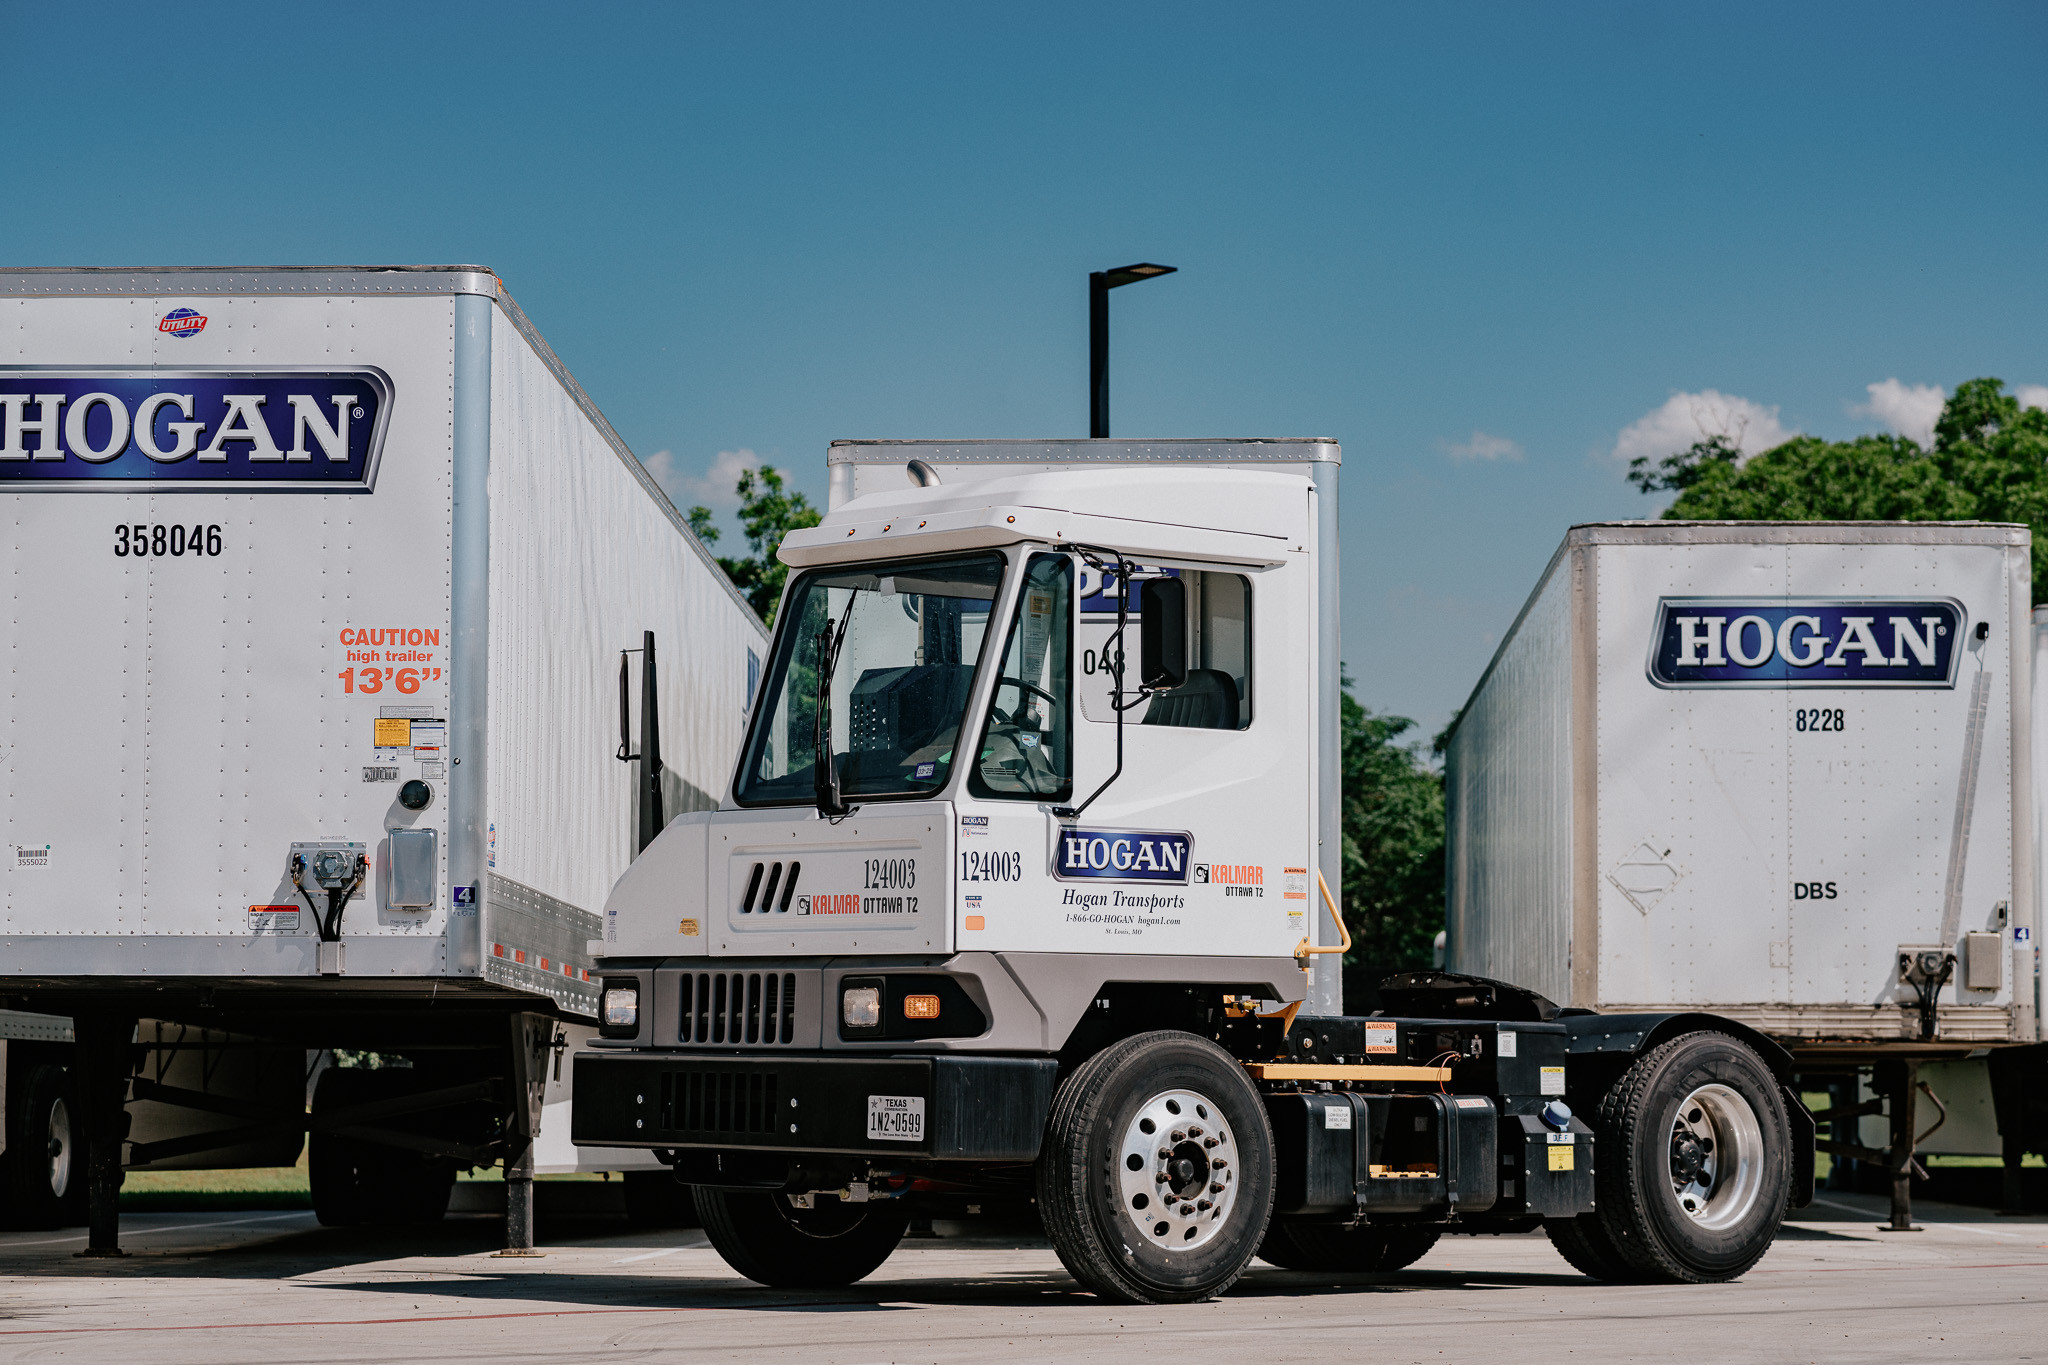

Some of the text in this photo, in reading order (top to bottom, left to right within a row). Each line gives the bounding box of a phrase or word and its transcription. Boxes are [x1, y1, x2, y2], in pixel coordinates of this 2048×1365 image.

[161, 317, 206, 331] UTILITY
[114, 524, 223, 557] 358046
[340, 628, 440, 646] CAUTION
[347, 650, 433, 664] high trailer
[1796, 708, 1844, 732] 8228
[963, 817, 987, 825] HOGAN
[18, 858, 48, 867] 3555022
[962, 851, 1021, 883] 124003
[863, 859, 916, 891] 124003
[1211, 865, 1263, 885] KALMAR
[458, 887, 471, 903] 4
[1225, 886, 1264, 897] OTTAWA T2
[1794, 881, 1838, 900] DBS
[812, 894, 918, 915] KALMAR OTTAWA T2
[1062, 888, 1185, 913] Hogan Transports
[1065, 913, 1181, 927] 1-866-GO-HOGAN hogan1.com
[885, 1099, 907, 1108] TEXAS
